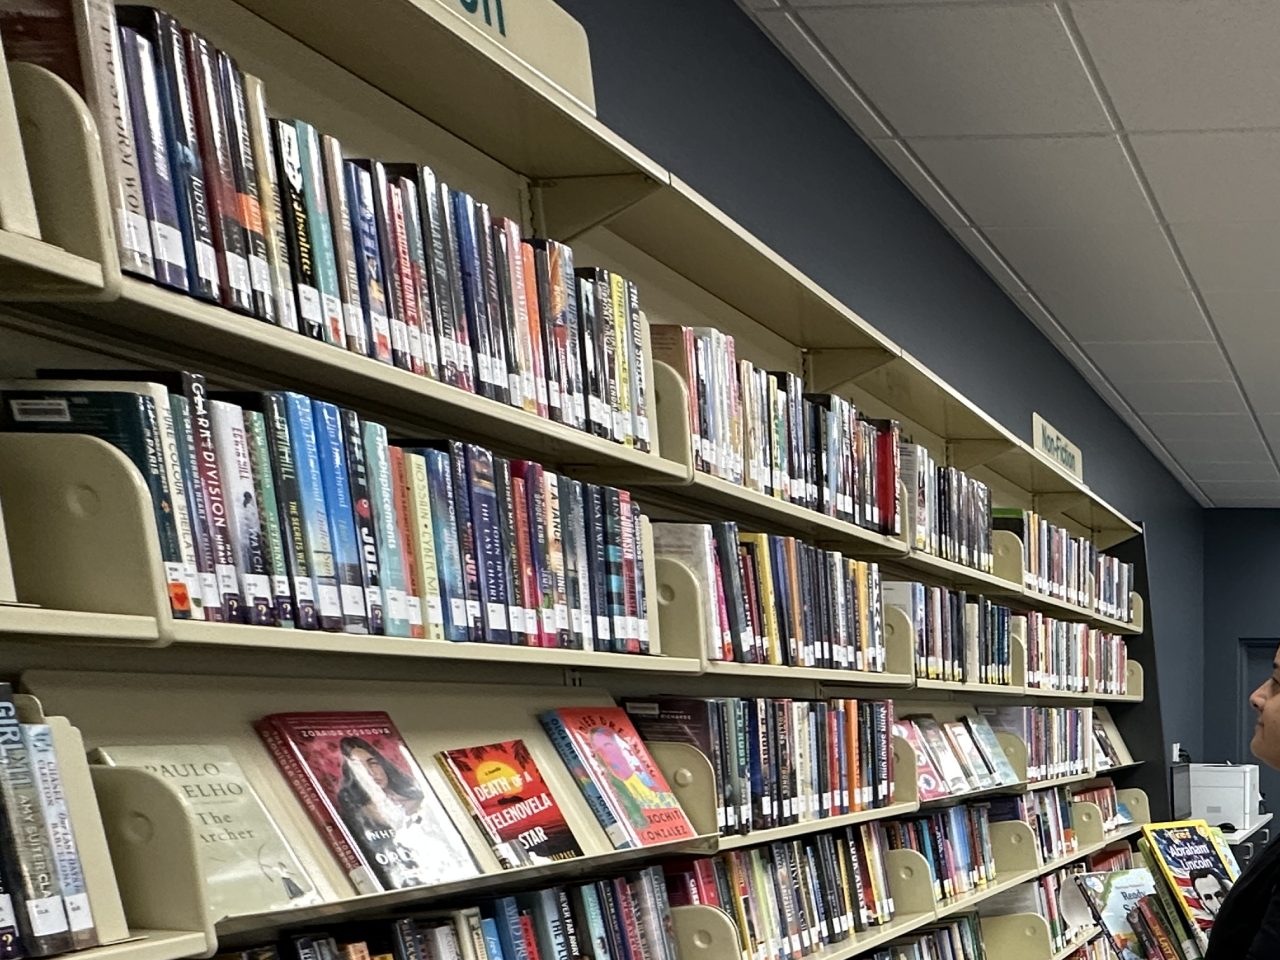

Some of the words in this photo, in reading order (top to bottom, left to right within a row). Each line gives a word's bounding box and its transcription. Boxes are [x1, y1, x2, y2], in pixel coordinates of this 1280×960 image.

[203, 450, 225, 528] DIVISION
[473, 777, 510, 802] DEATH
[487, 797, 552, 832] TELENOVELA
[518, 827, 548, 849] STAR
[558, 891, 571, 918] NEVER
[564, 918, 574, 935] FAR
[568, 935, 579, 957] AWAY
